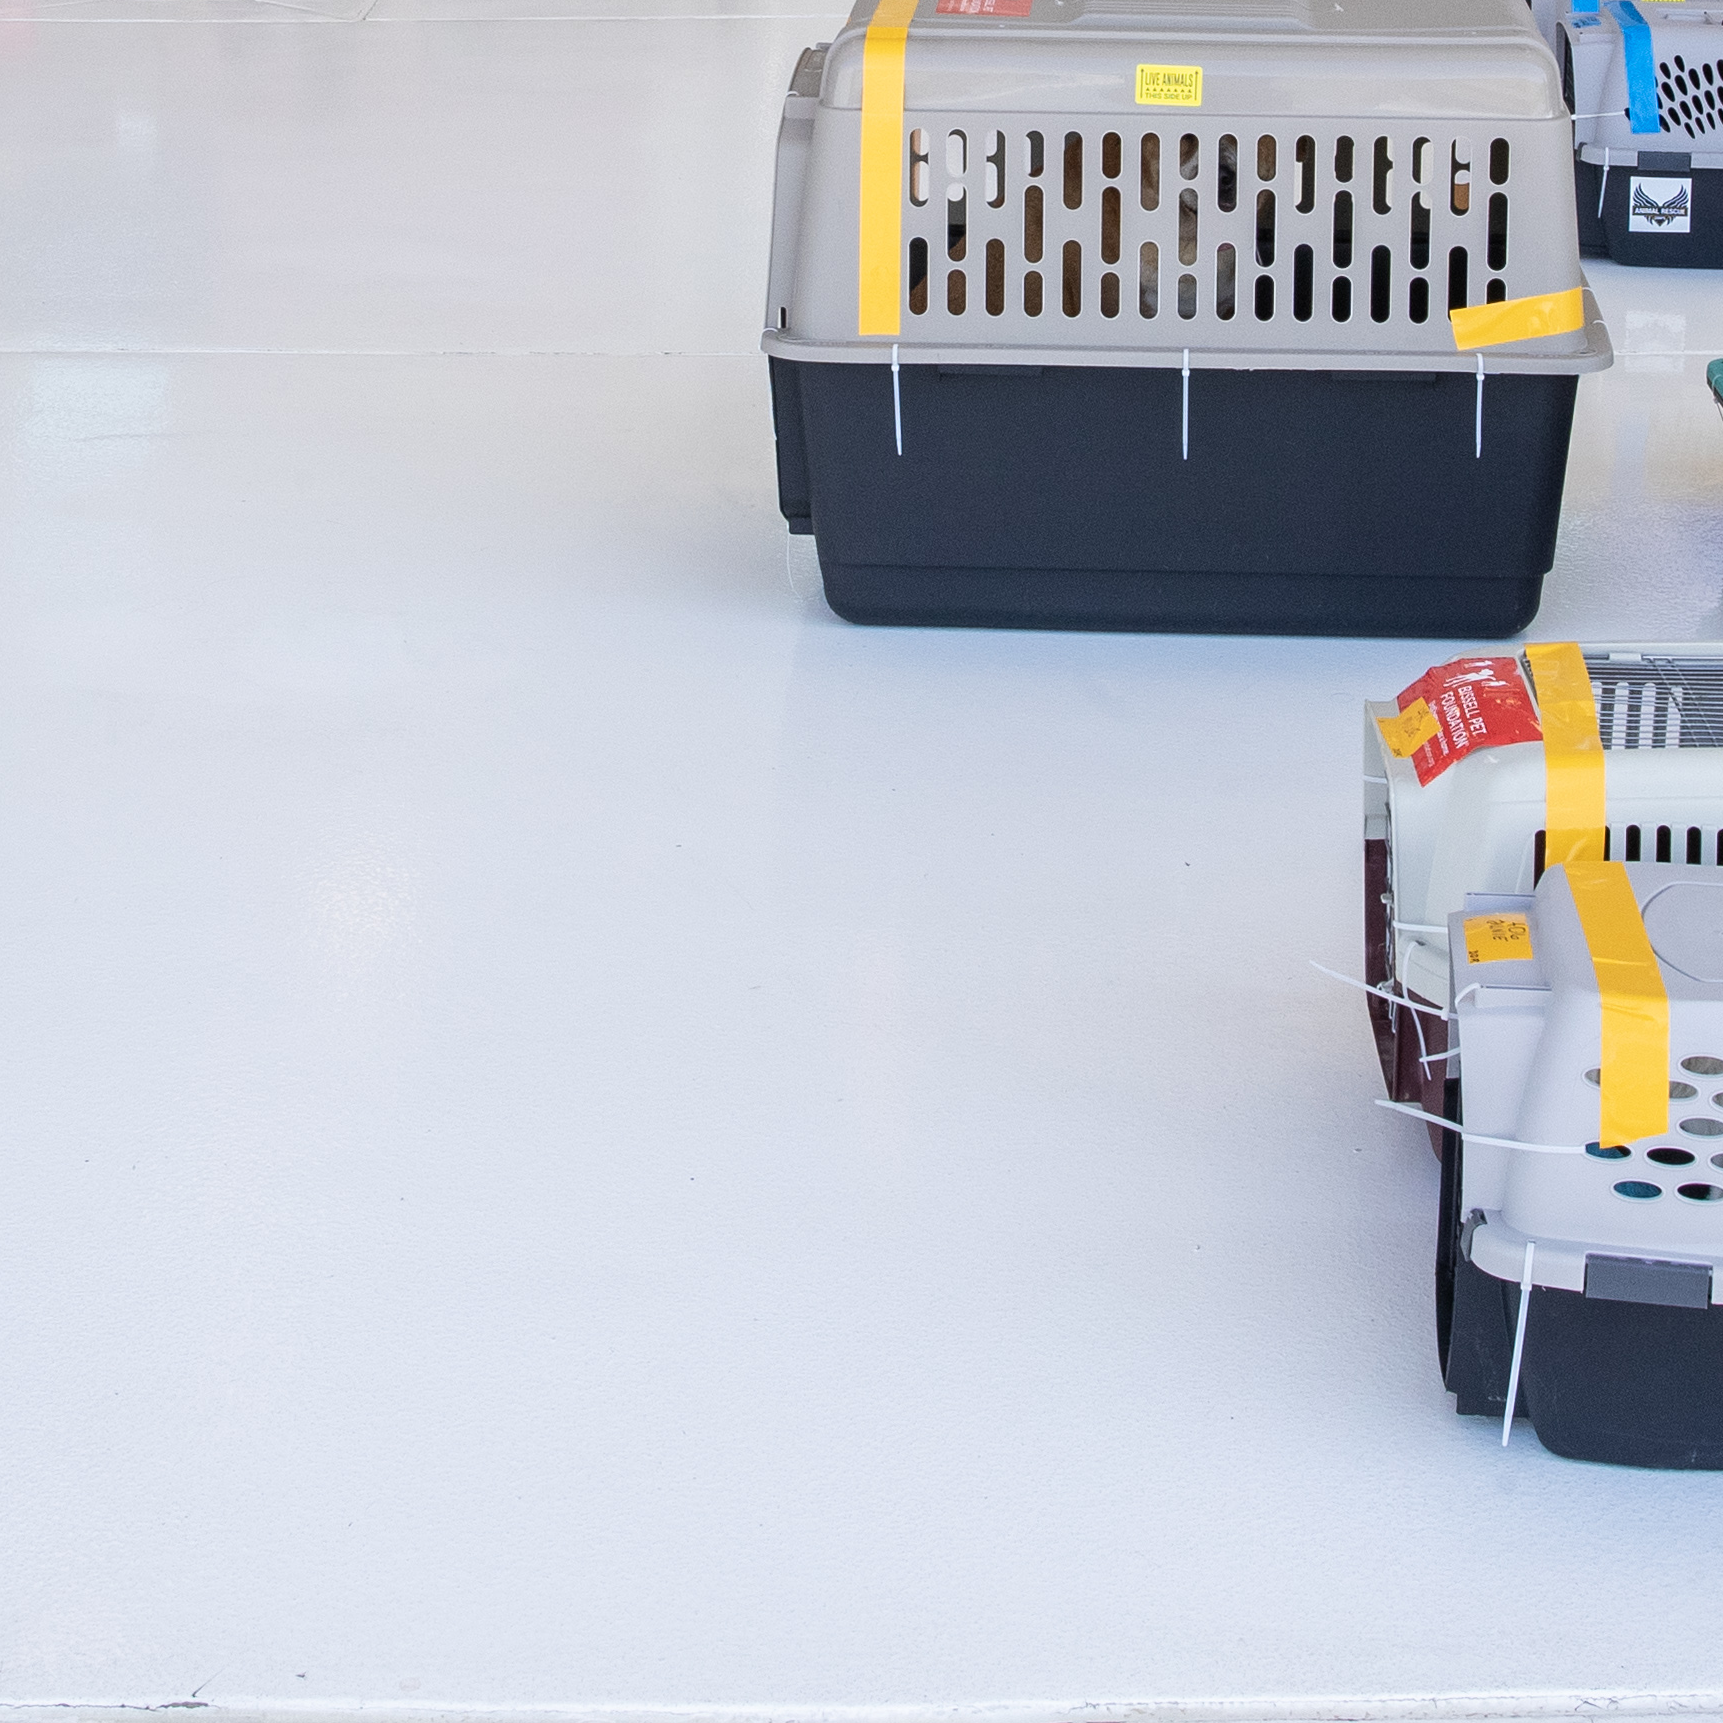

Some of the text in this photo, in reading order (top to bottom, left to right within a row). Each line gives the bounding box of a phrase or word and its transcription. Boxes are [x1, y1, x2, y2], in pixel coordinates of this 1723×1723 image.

[1145, 73, 1194, 88] LIVE ANIMALS
[1441, 691, 1469, 749] FOUNDATION
[1457, 685, 1487, 737] BISSELL PET
